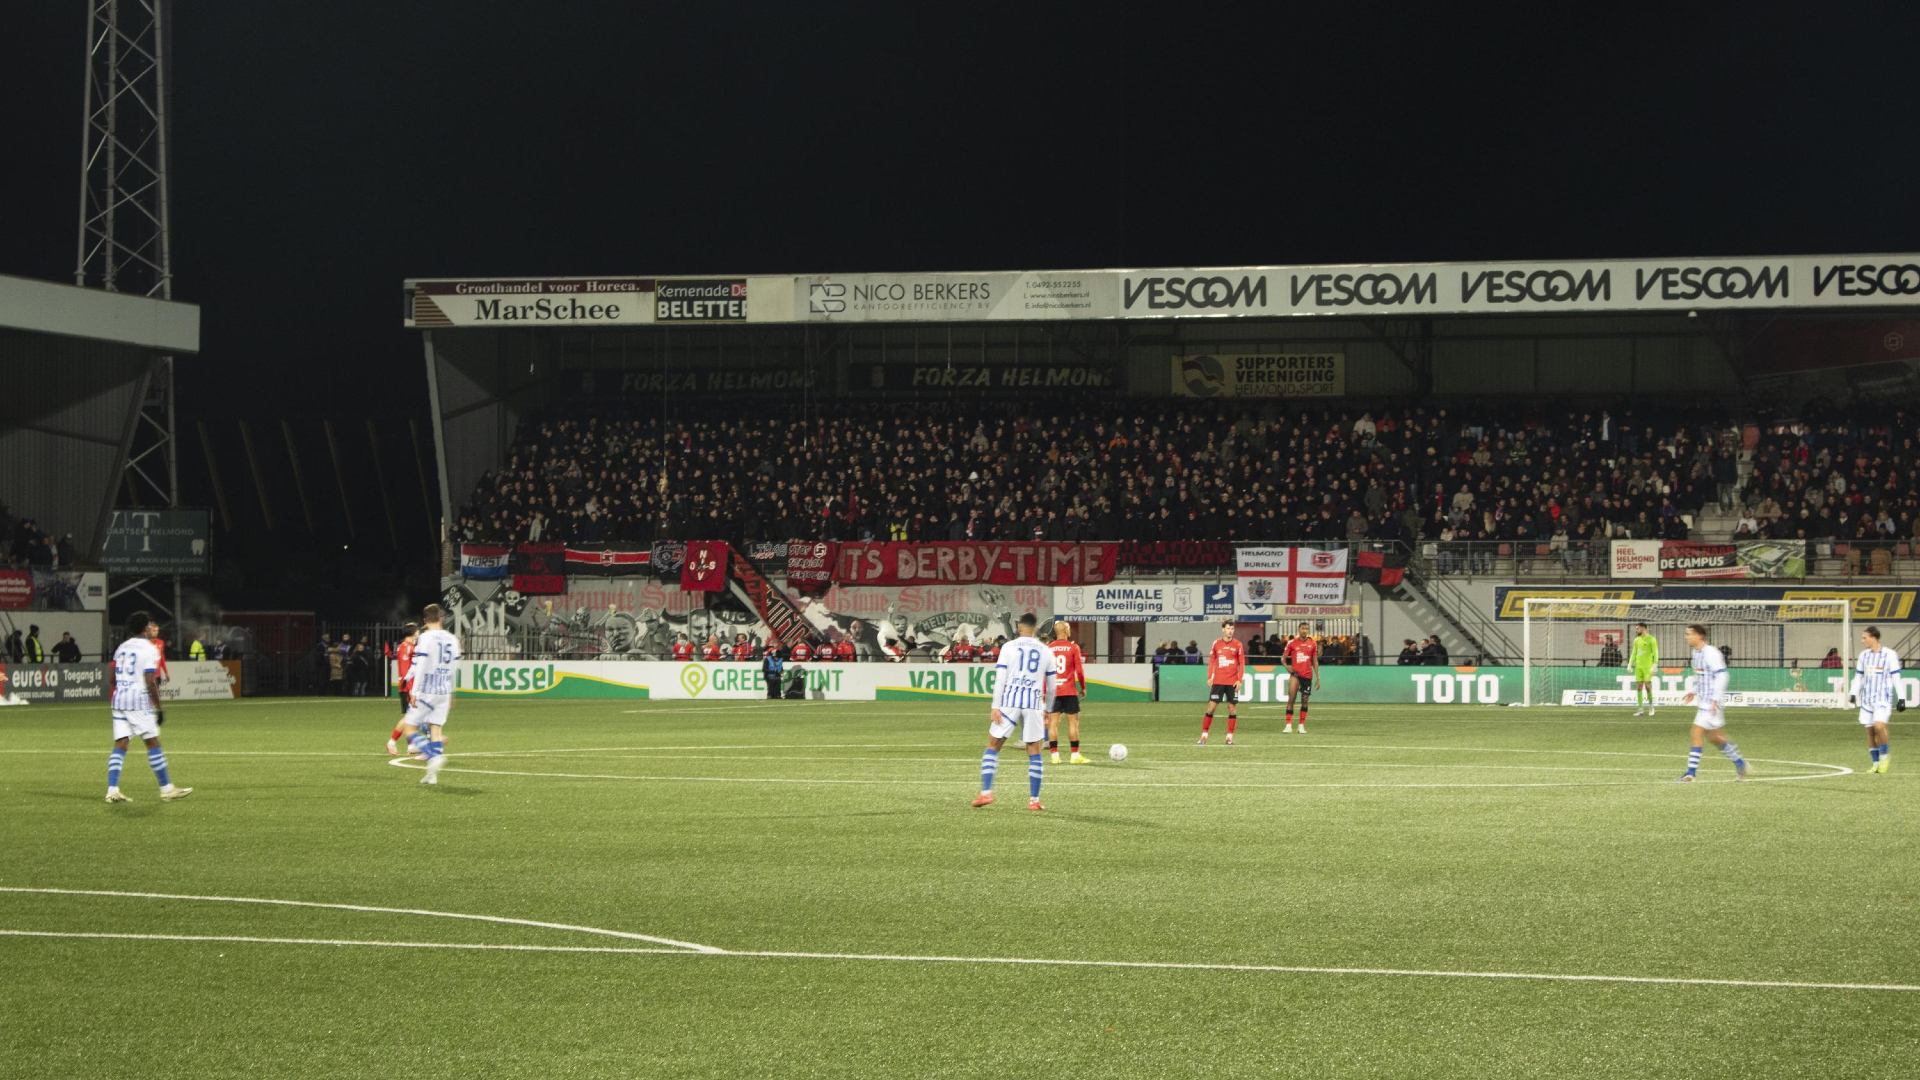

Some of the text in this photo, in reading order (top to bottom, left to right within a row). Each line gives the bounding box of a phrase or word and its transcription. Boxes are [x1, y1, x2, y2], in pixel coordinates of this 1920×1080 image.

[455, 280, 640, 294] Groothandel voor Horeca.
[1291, 273, 1436, 306] VESCOM
[1461, 269, 1611, 304] VESCOM
[1636, 265, 1788, 301] VESCOM
[657, 285, 729, 297] Kemenade
[854, 282, 990, 301] NICO BERKERS
[1030, 286, 1090, 299] www.nicoberkers.nl
[1124, 276, 1266, 309] VESCOM
[475, 298, 620, 321] MarSchee
[853, 302, 990, 311] KANTOOREFFICIENCY BV
[1032, 301, 1092, 309] info@nicoberkers.nl
[1235, 356, 1335, 369] SUPPORTERS
[620, 372, 697, 391] FORZA
[912, 366, 991, 387] FORZA
[1235, 370, 1335, 382] VERENIGING
[150, 527, 194, 536] HELMOND
[788, 544, 812, 556] STOP
[1702, 545, 1736, 556] NAAR
[466, 556, 502, 567] HORST
[896, 545, 1106, 584] DERBY-TIME
[1616, 555, 1655, 563] HELMOND
[1660, 556, 1724, 569] DE CAMPUS
[1305, 581, 1339, 589] FRIENDS
[1095, 588, 1163, 600] ANIMALE
[1095, 600, 1163, 612] Beveiliging
[1285, 606, 1311, 615] FOOD
[1319, 606, 1352, 615] DRINKS
[437, 641, 452, 664] 15
[115, 651, 136, 676] 33
[1018, 647, 1040, 674] 18
[1056, 654, 1067, 675] 9
[12, 665, 59, 688] eureka
[63, 668, 102, 684] Toegang is
[473, 663, 554, 691] Kessel
[712, 669, 844, 693] GREEPINT
[909, 670, 956, 692] van
[63, 685, 101, 698] maatwerk
[1410, 673, 1499, 703] TOTO
[1747, 696, 1839, 704] STAALWERKEN
